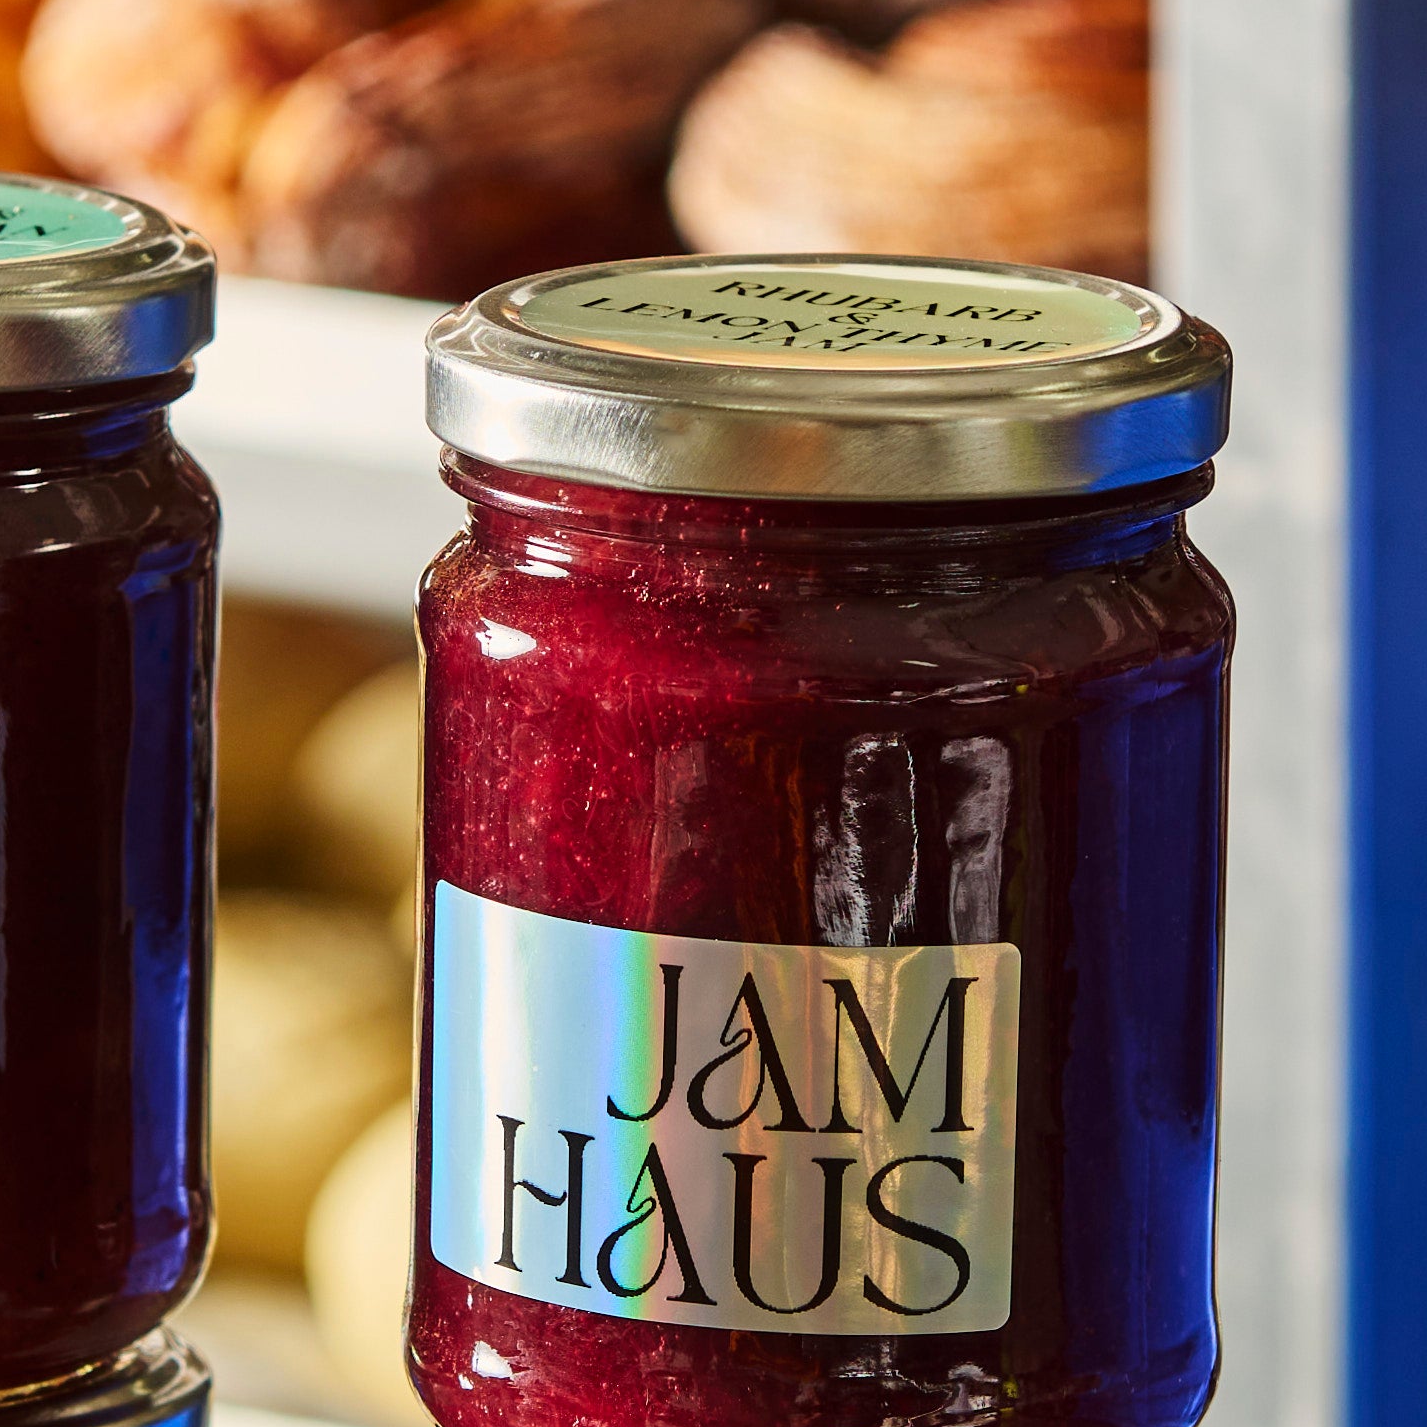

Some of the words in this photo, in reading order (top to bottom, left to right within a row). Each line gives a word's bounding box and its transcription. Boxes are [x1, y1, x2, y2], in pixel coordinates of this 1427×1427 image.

[577, 297, 822, 334] LEMON
[846, 326, 1072, 354] THYME
[713, 280, 1042, 324] RHUBARB
[828, 310, 878, 326] &
[714, 333, 871, 353] JAM
[607, 964, 979, 1133] JAM
[494, 1114, 972, 1316] HAUS
